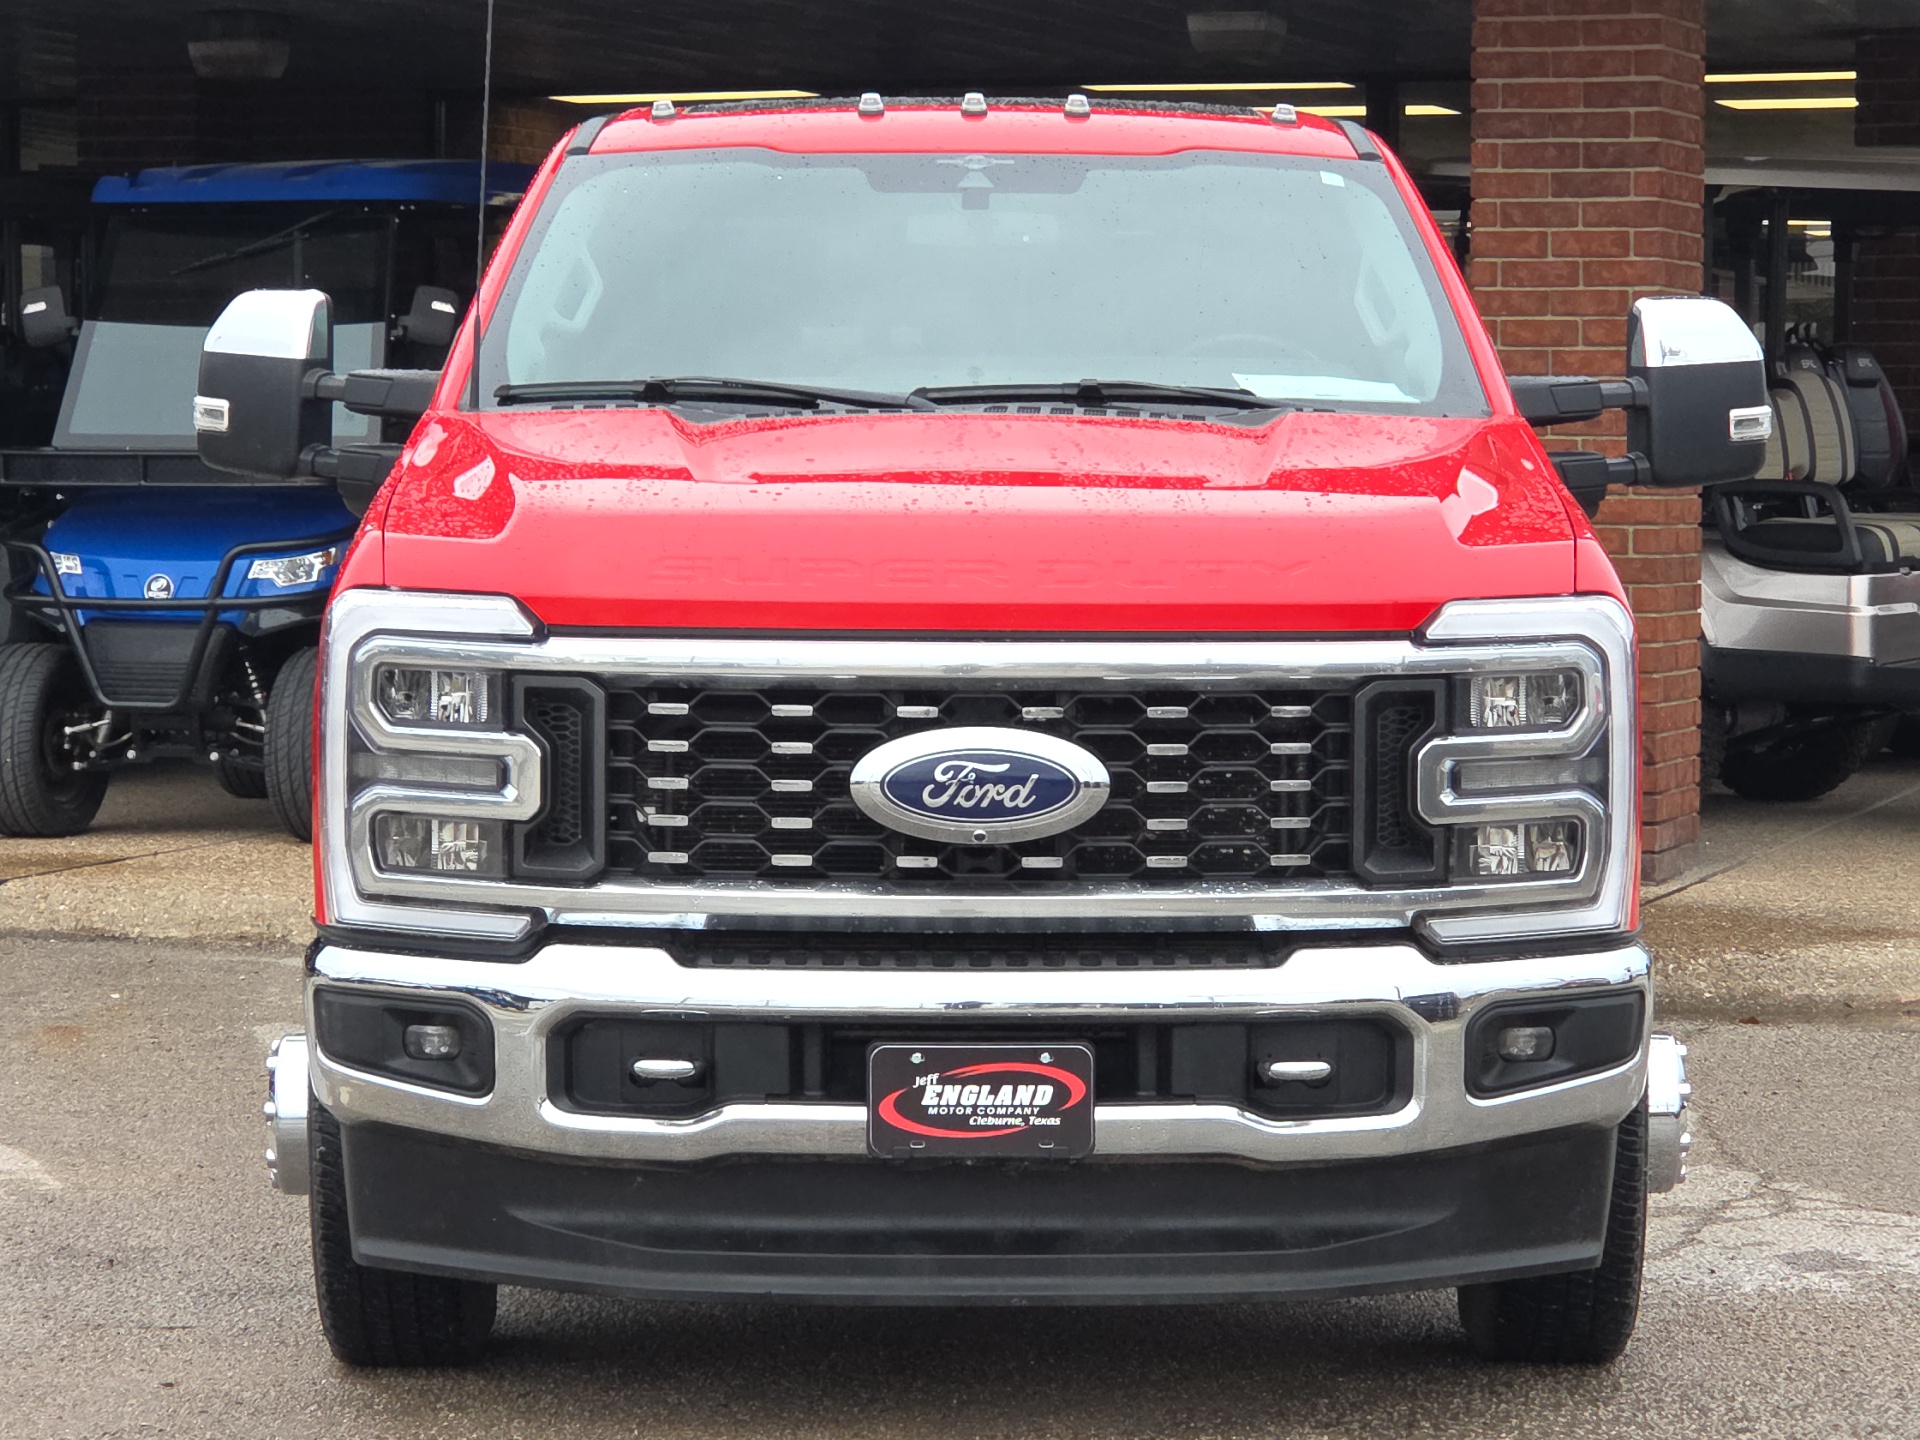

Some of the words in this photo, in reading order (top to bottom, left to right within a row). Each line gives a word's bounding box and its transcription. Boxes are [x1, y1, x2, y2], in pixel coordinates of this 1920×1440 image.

[922, 760, 1040, 808] Ford
[912, 1072, 940, 1089] Jeff
[920, 1084, 1054, 1106] ENGLAND
[927, 1106, 973, 1115] MOTOR
[976, 1106, 1041, 1115] COMPANY
[968, 1115, 1025, 1127] Cleburne,
[1028, 1116, 1061, 1126] Texas
